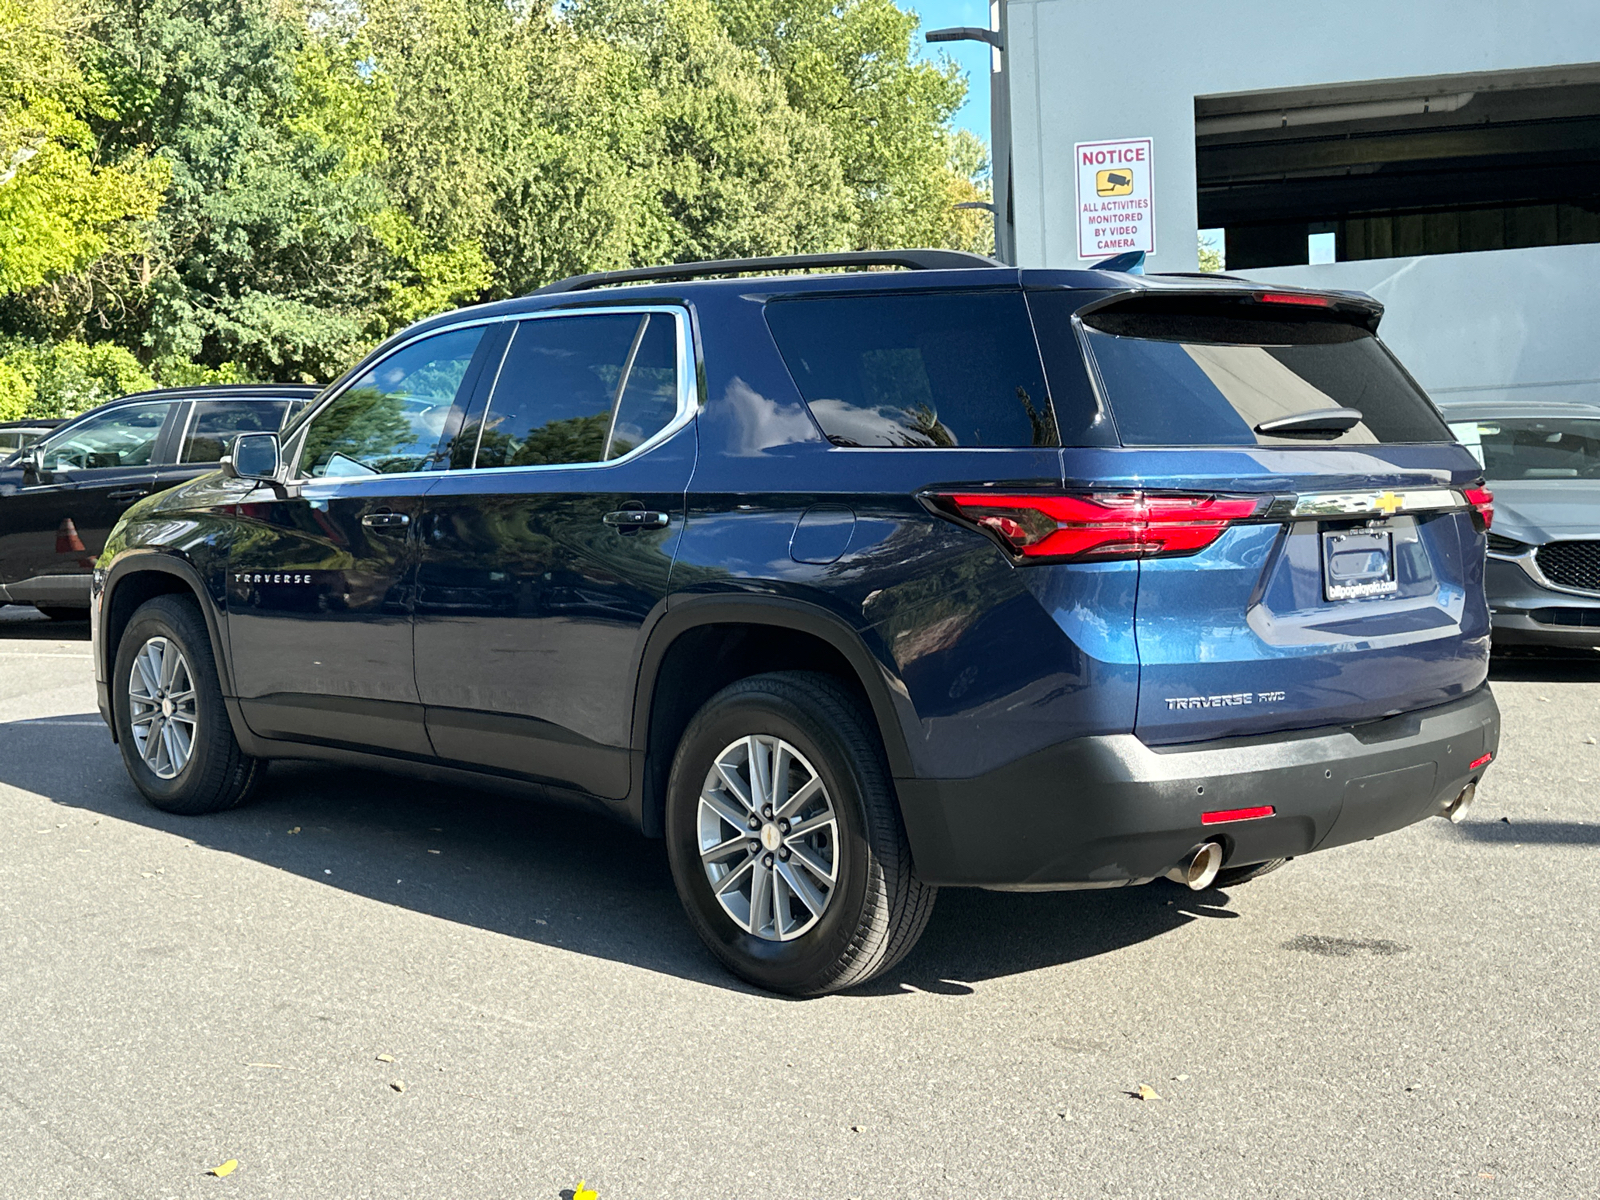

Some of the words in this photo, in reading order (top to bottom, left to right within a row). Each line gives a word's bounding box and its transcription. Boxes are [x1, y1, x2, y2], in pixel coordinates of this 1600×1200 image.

[1082, 148, 1145, 165] NOTICE
[1083, 203, 1098, 212] ALL
[1101, 199, 1148, 211] ACTIVITIES
[1089, 212, 1143, 224] MONITORED
[1094, 228, 1106, 237] BY
[1109, 226, 1137, 236] VIDEO
[1097, 239, 1135, 249] CAMERA
[234, 574, 311, 584] TRAVERSE
[1165, 693, 1253, 710] TRAVERSE
[1258, 691, 1286, 702] AWD
